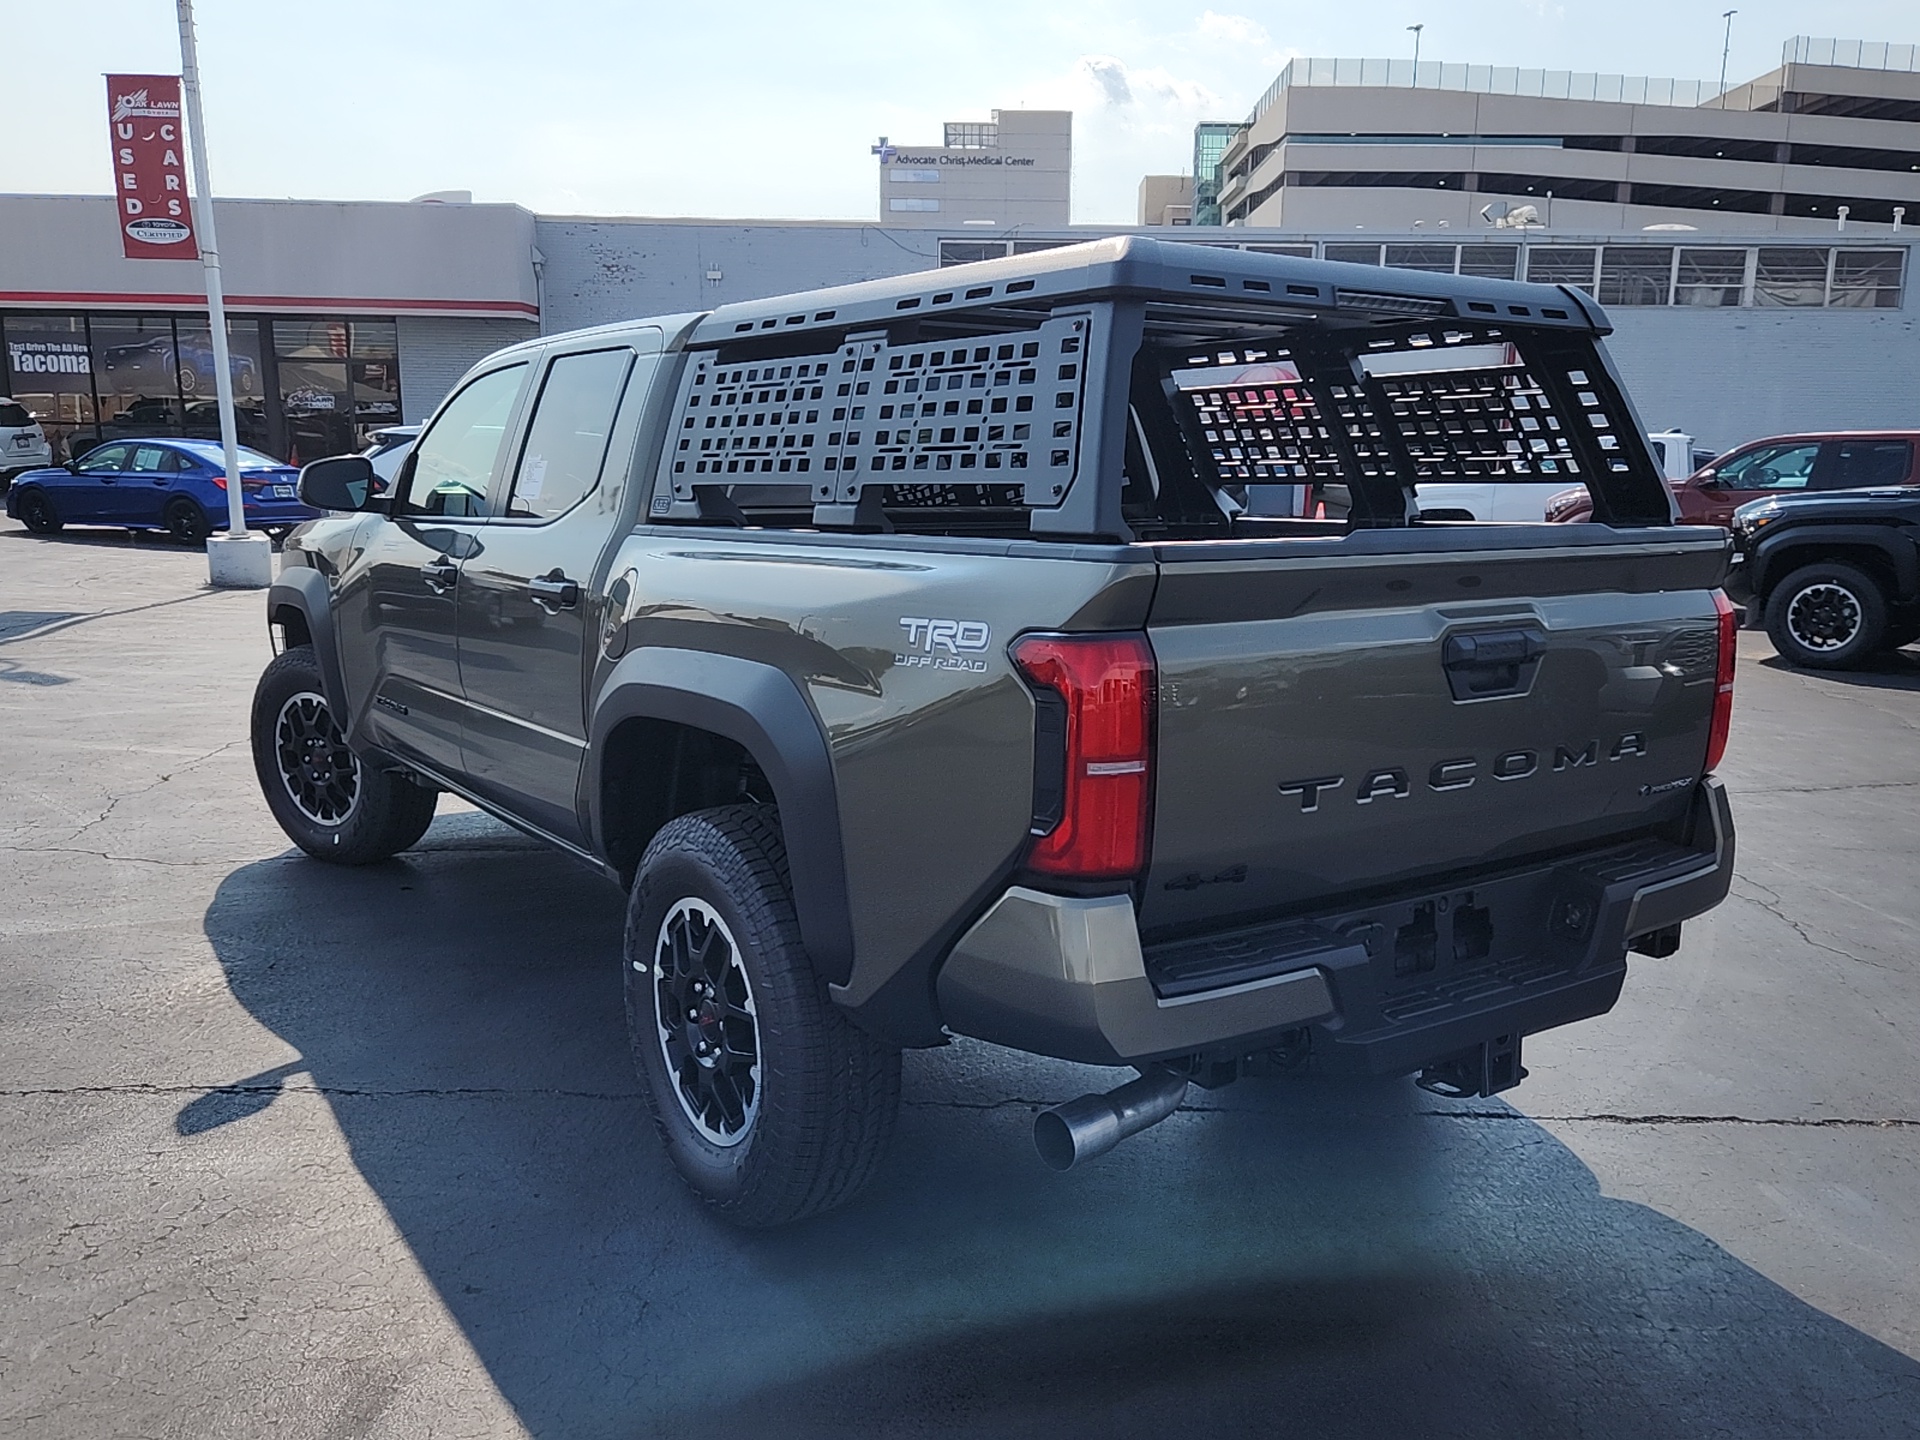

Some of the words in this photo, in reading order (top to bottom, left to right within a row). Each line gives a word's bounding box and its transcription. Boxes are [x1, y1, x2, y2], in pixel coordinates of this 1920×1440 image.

[150, 101, 179, 109] LAWN
[117, 123, 143, 215] USED
[160, 124, 182, 216] CARS
[895, 155, 937, 165] Advocate
[940, 155, 964, 165] Christ
[967, 156, 1002, 165] Medical
[1005, 156, 1034, 166] Center
[9, 342, 25, 351] Test
[26, 343, 46, 351] Drive
[47, 343, 61, 352] The
[9, 351, 90, 373] Tacoma
[900, 617, 991, 655] TRD
[894, 653, 932, 668] OFF
[933, 655, 988, 673] ROAD
[1277, 731, 1648, 813] TACOMA
